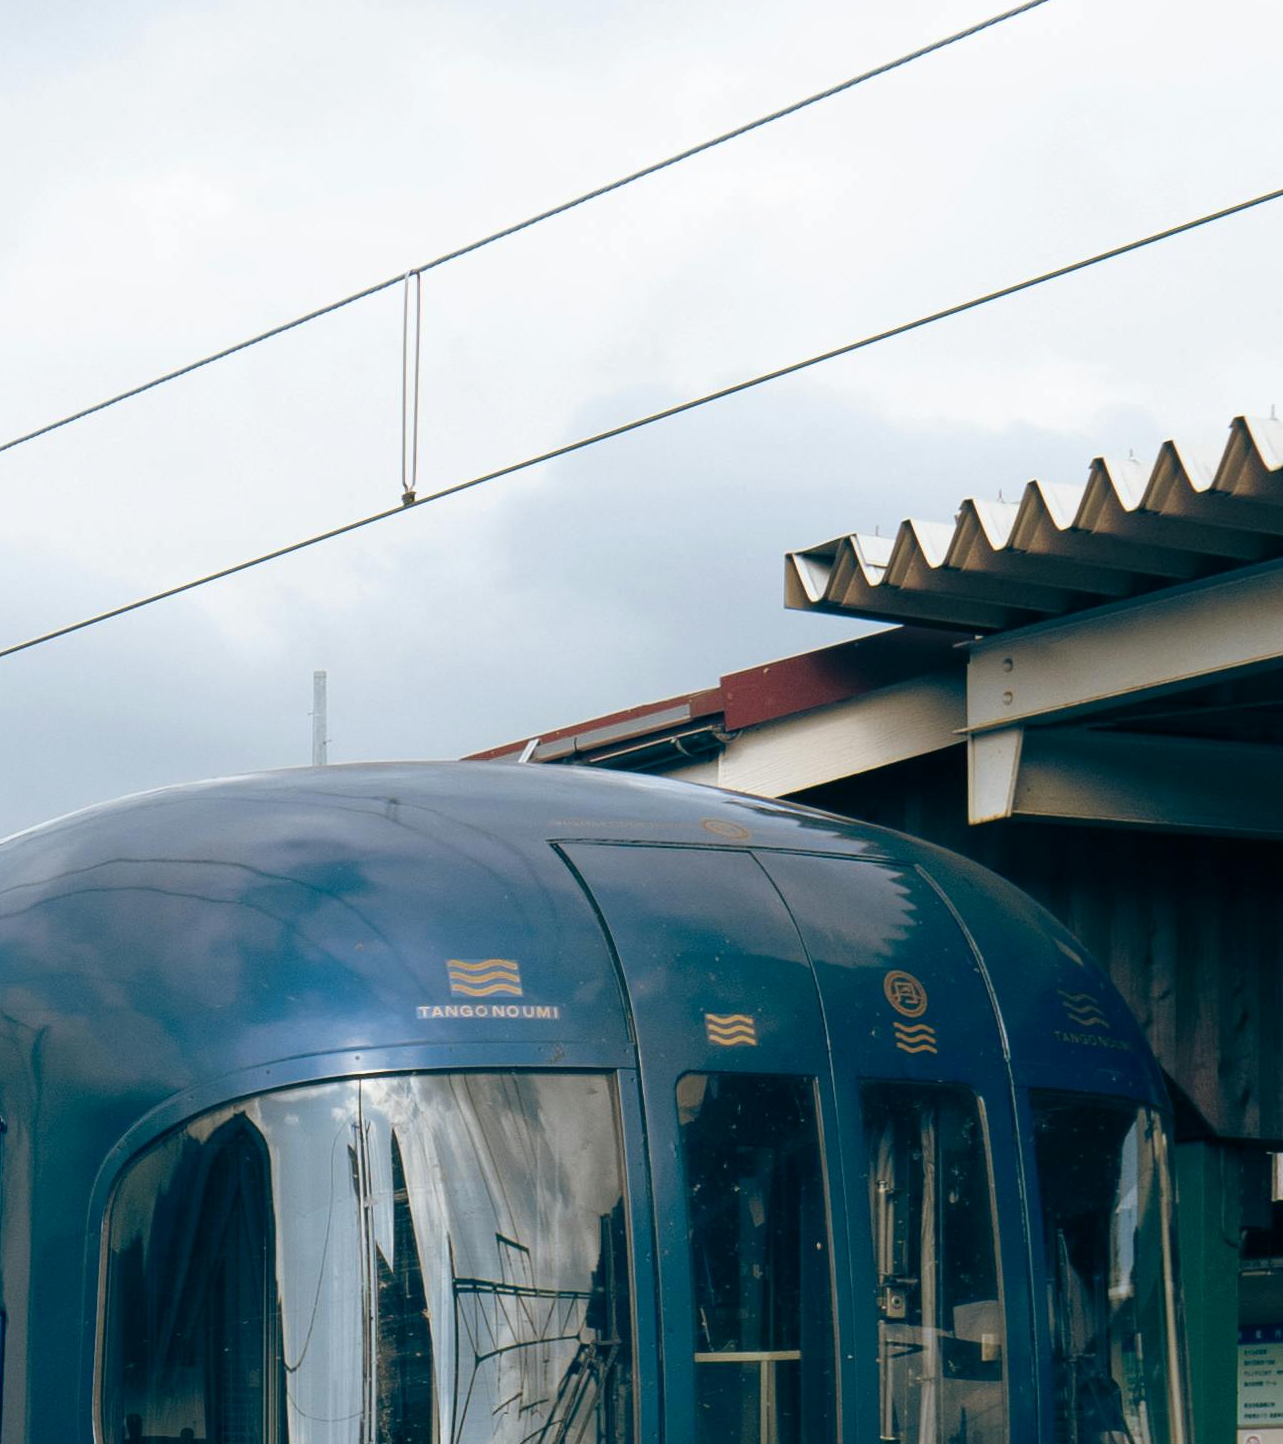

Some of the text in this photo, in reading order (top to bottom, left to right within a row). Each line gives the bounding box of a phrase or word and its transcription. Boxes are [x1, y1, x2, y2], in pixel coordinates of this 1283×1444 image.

[418, 1005, 559, 1019] TANGO NO UMI
